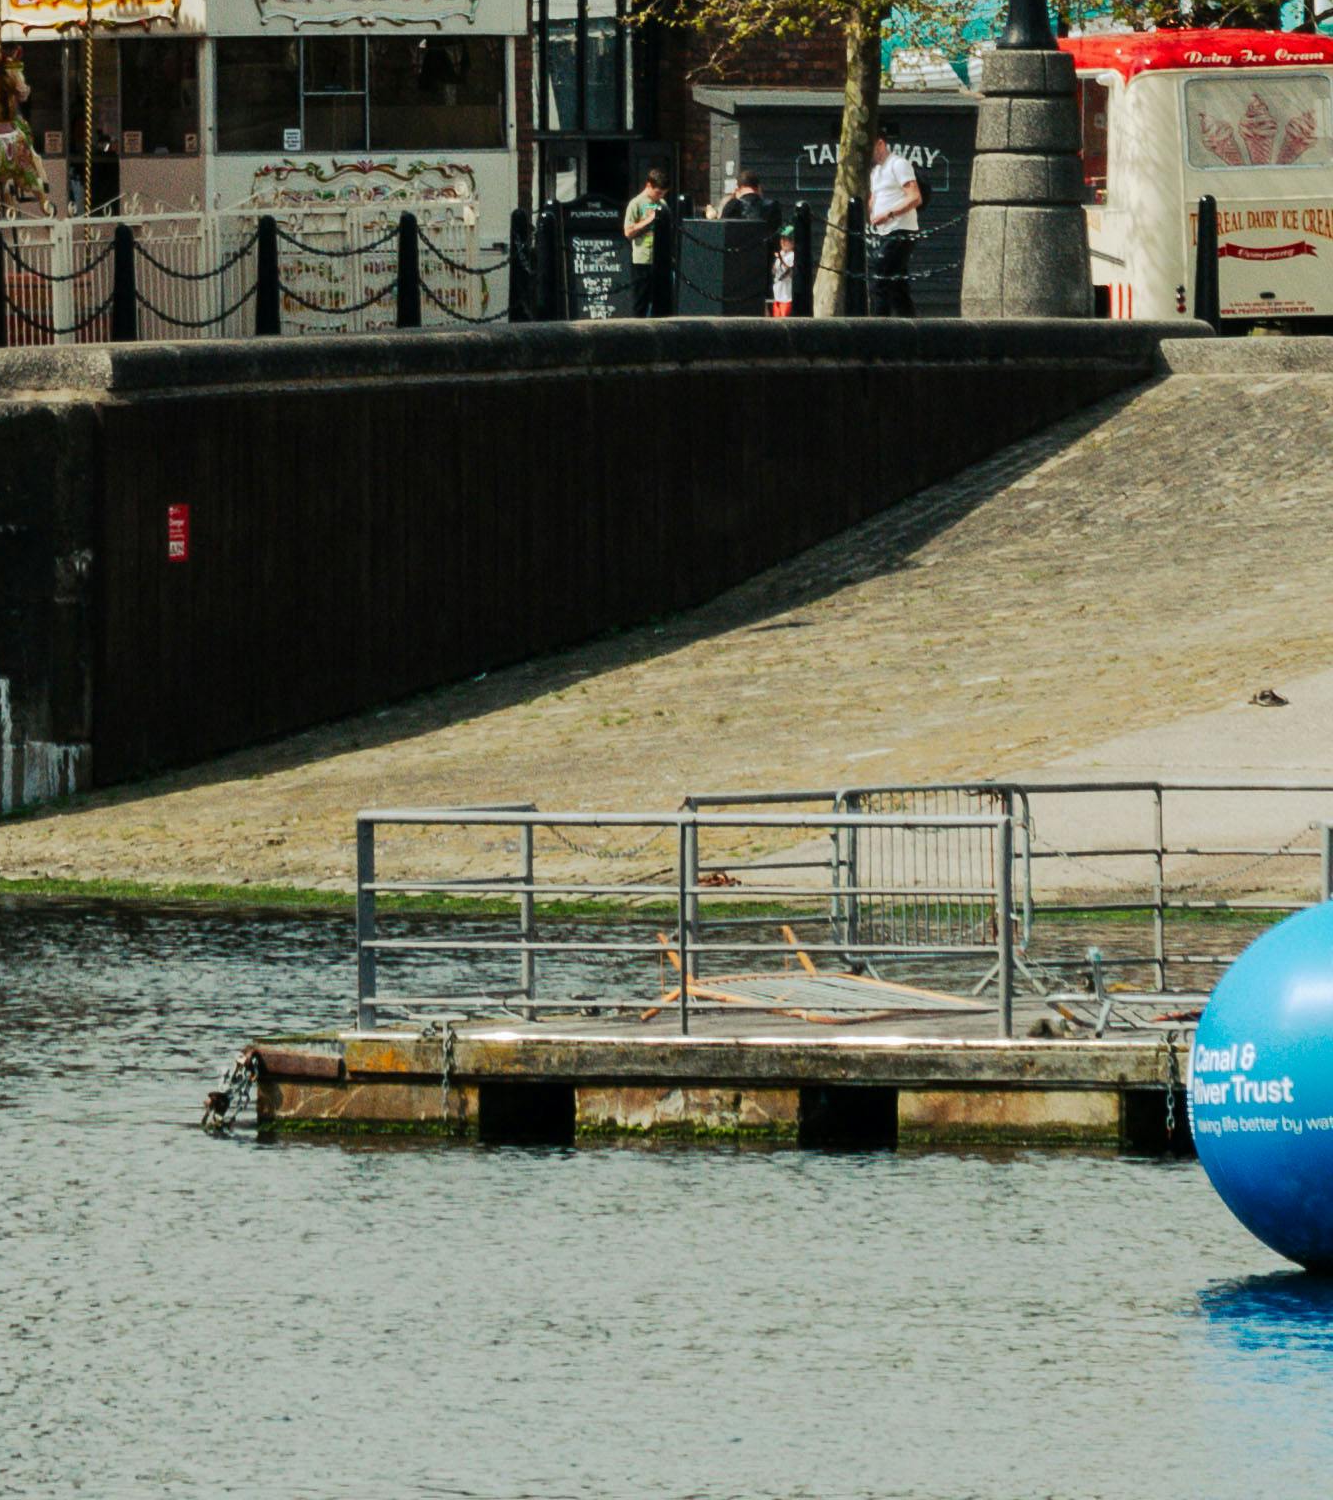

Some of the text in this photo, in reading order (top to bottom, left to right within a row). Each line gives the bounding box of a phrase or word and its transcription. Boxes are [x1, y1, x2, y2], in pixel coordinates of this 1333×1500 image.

[1183, 48, 1325, 65] Dairy Ice Cream
[803, 143, 942, 168] TAWAY
[1216, 211, 1245, 236] REAL
[1247, 210, 1278, 229] DAIRY
[1282, 209, 1299, 230] ICE
[1301, 208, 1333, 240] CREA
[1195, 1042, 1256, 1073] Canal &
[1231, 1074, 1294, 1105] Trust
[1239, 1115, 1280, 1132] better
[1281, 1114, 1303, 1135] by
